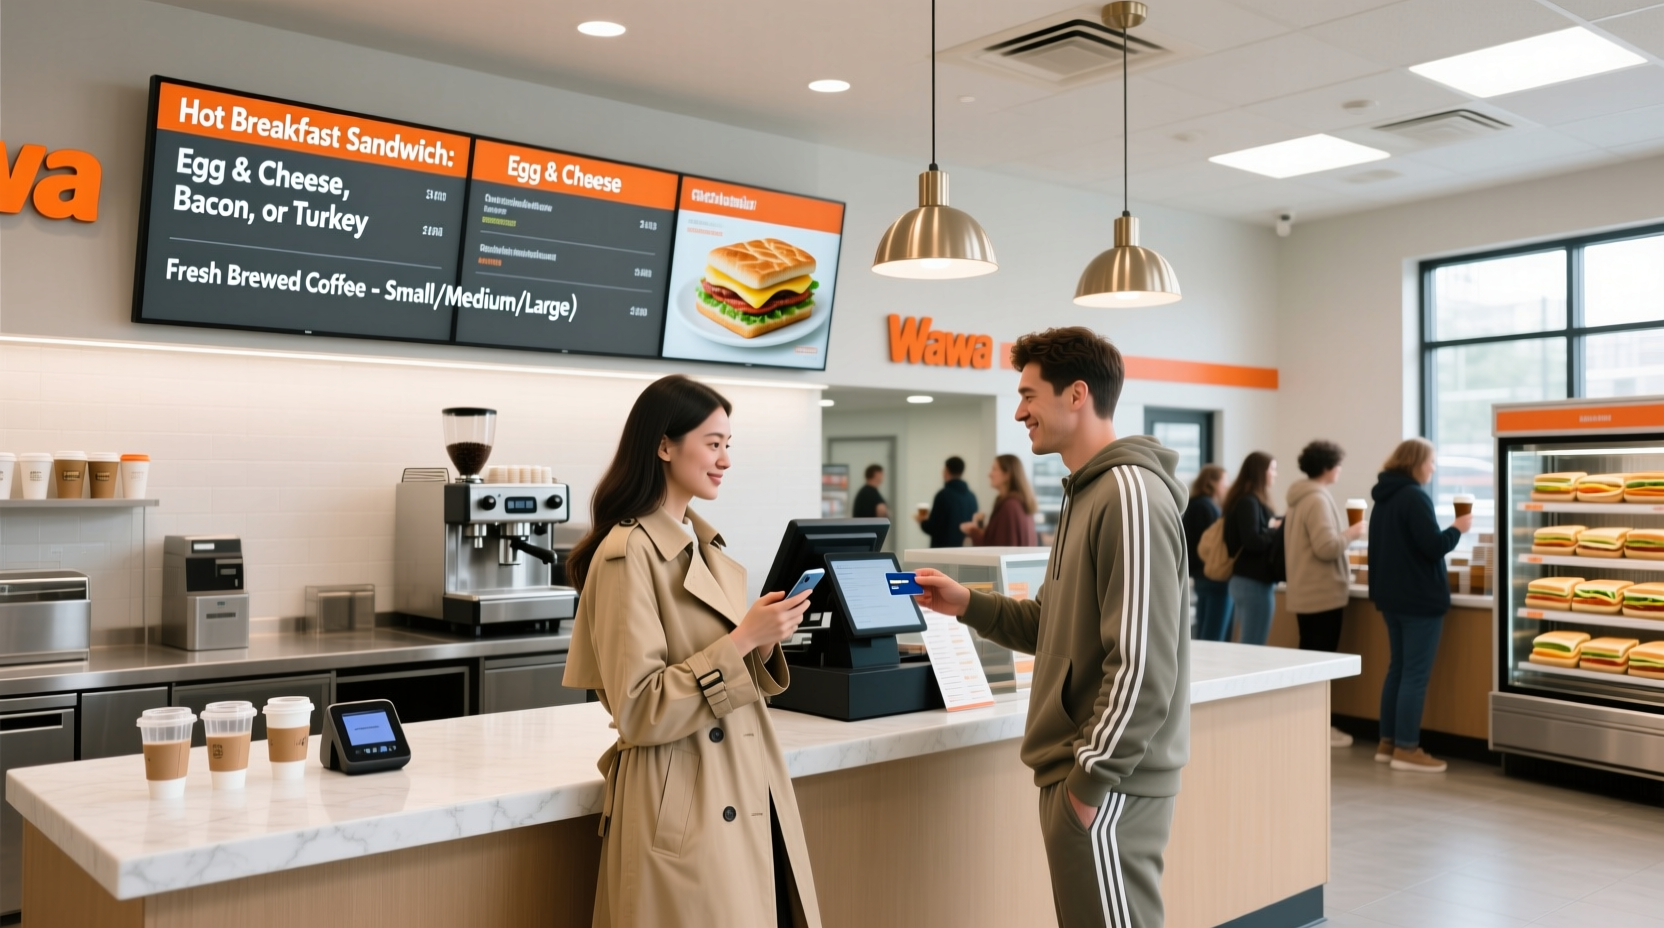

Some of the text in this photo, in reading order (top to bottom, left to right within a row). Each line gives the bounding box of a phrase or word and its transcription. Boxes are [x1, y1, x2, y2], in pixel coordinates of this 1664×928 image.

[179, 97, 455, 168] Hot Breakfast Sandwich:
[176, 147, 350, 202] Egg & Cheese,
[507, 155, 622, 193] Egg & Cheese
[173, 184, 370, 240] Bacon, or Turkey
[166, 257, 222, 285] Fresh
[227, 263, 302, 292] Brewed
[305, 271, 367, 298] Coffee
[384, 279, 578, 323] Small/Medium/Large)
[886, 313, 994, 370] Wawa
